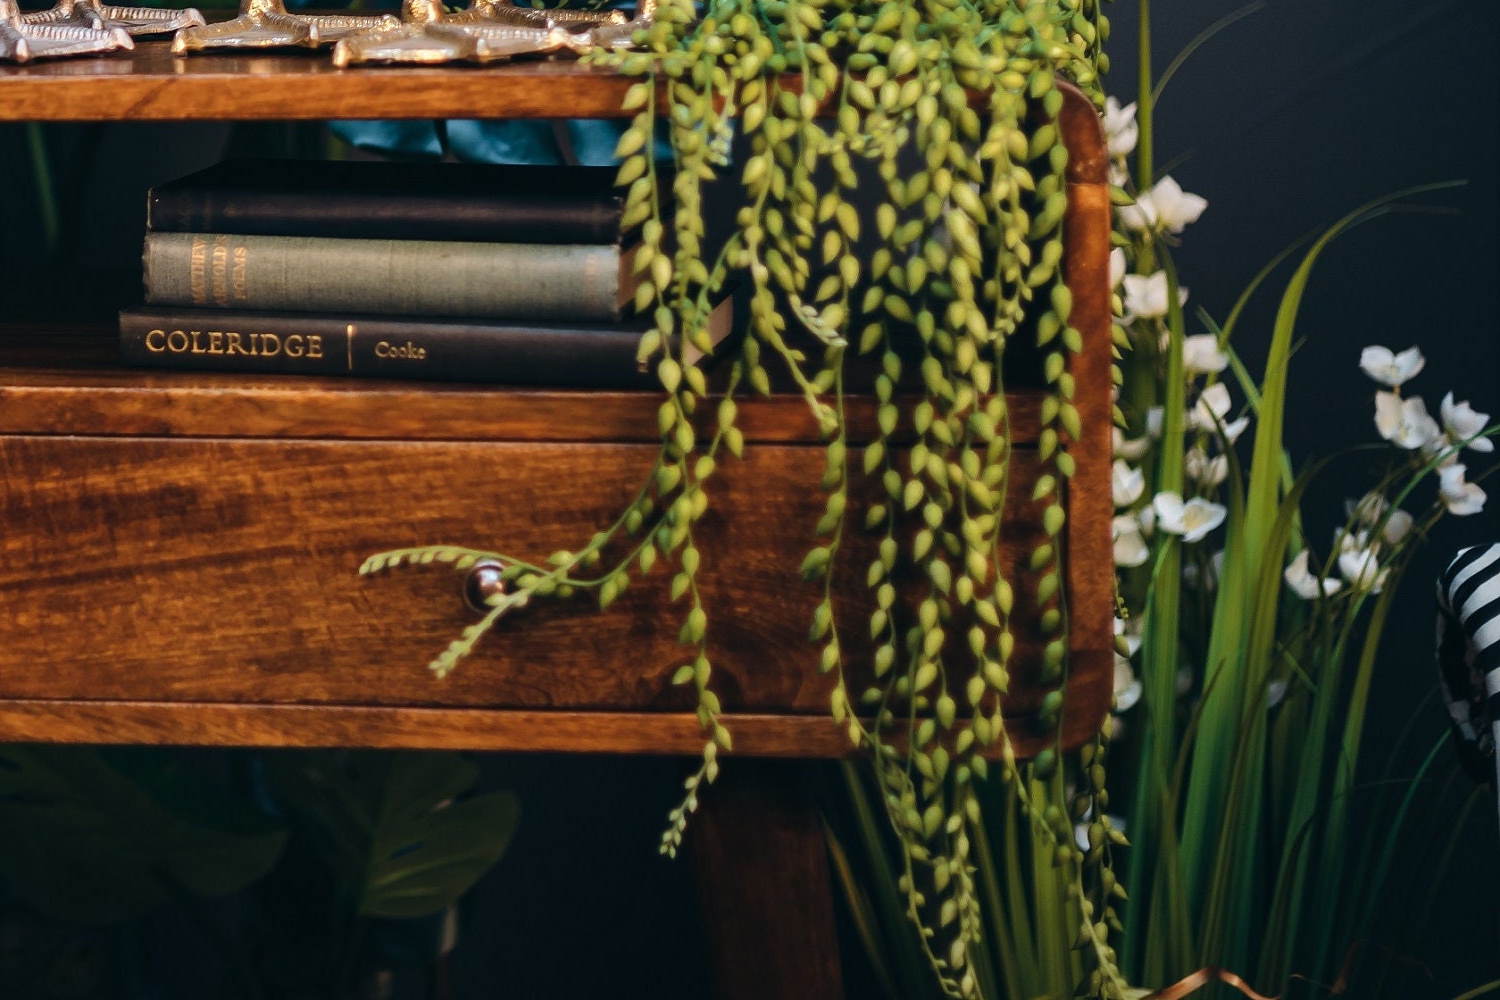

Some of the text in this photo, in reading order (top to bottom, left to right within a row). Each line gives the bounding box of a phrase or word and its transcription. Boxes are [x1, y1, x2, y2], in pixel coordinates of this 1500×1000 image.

[233, 246, 248, 299] POEMS
[145, 329, 428, 360] COLERIDGE Cooke
